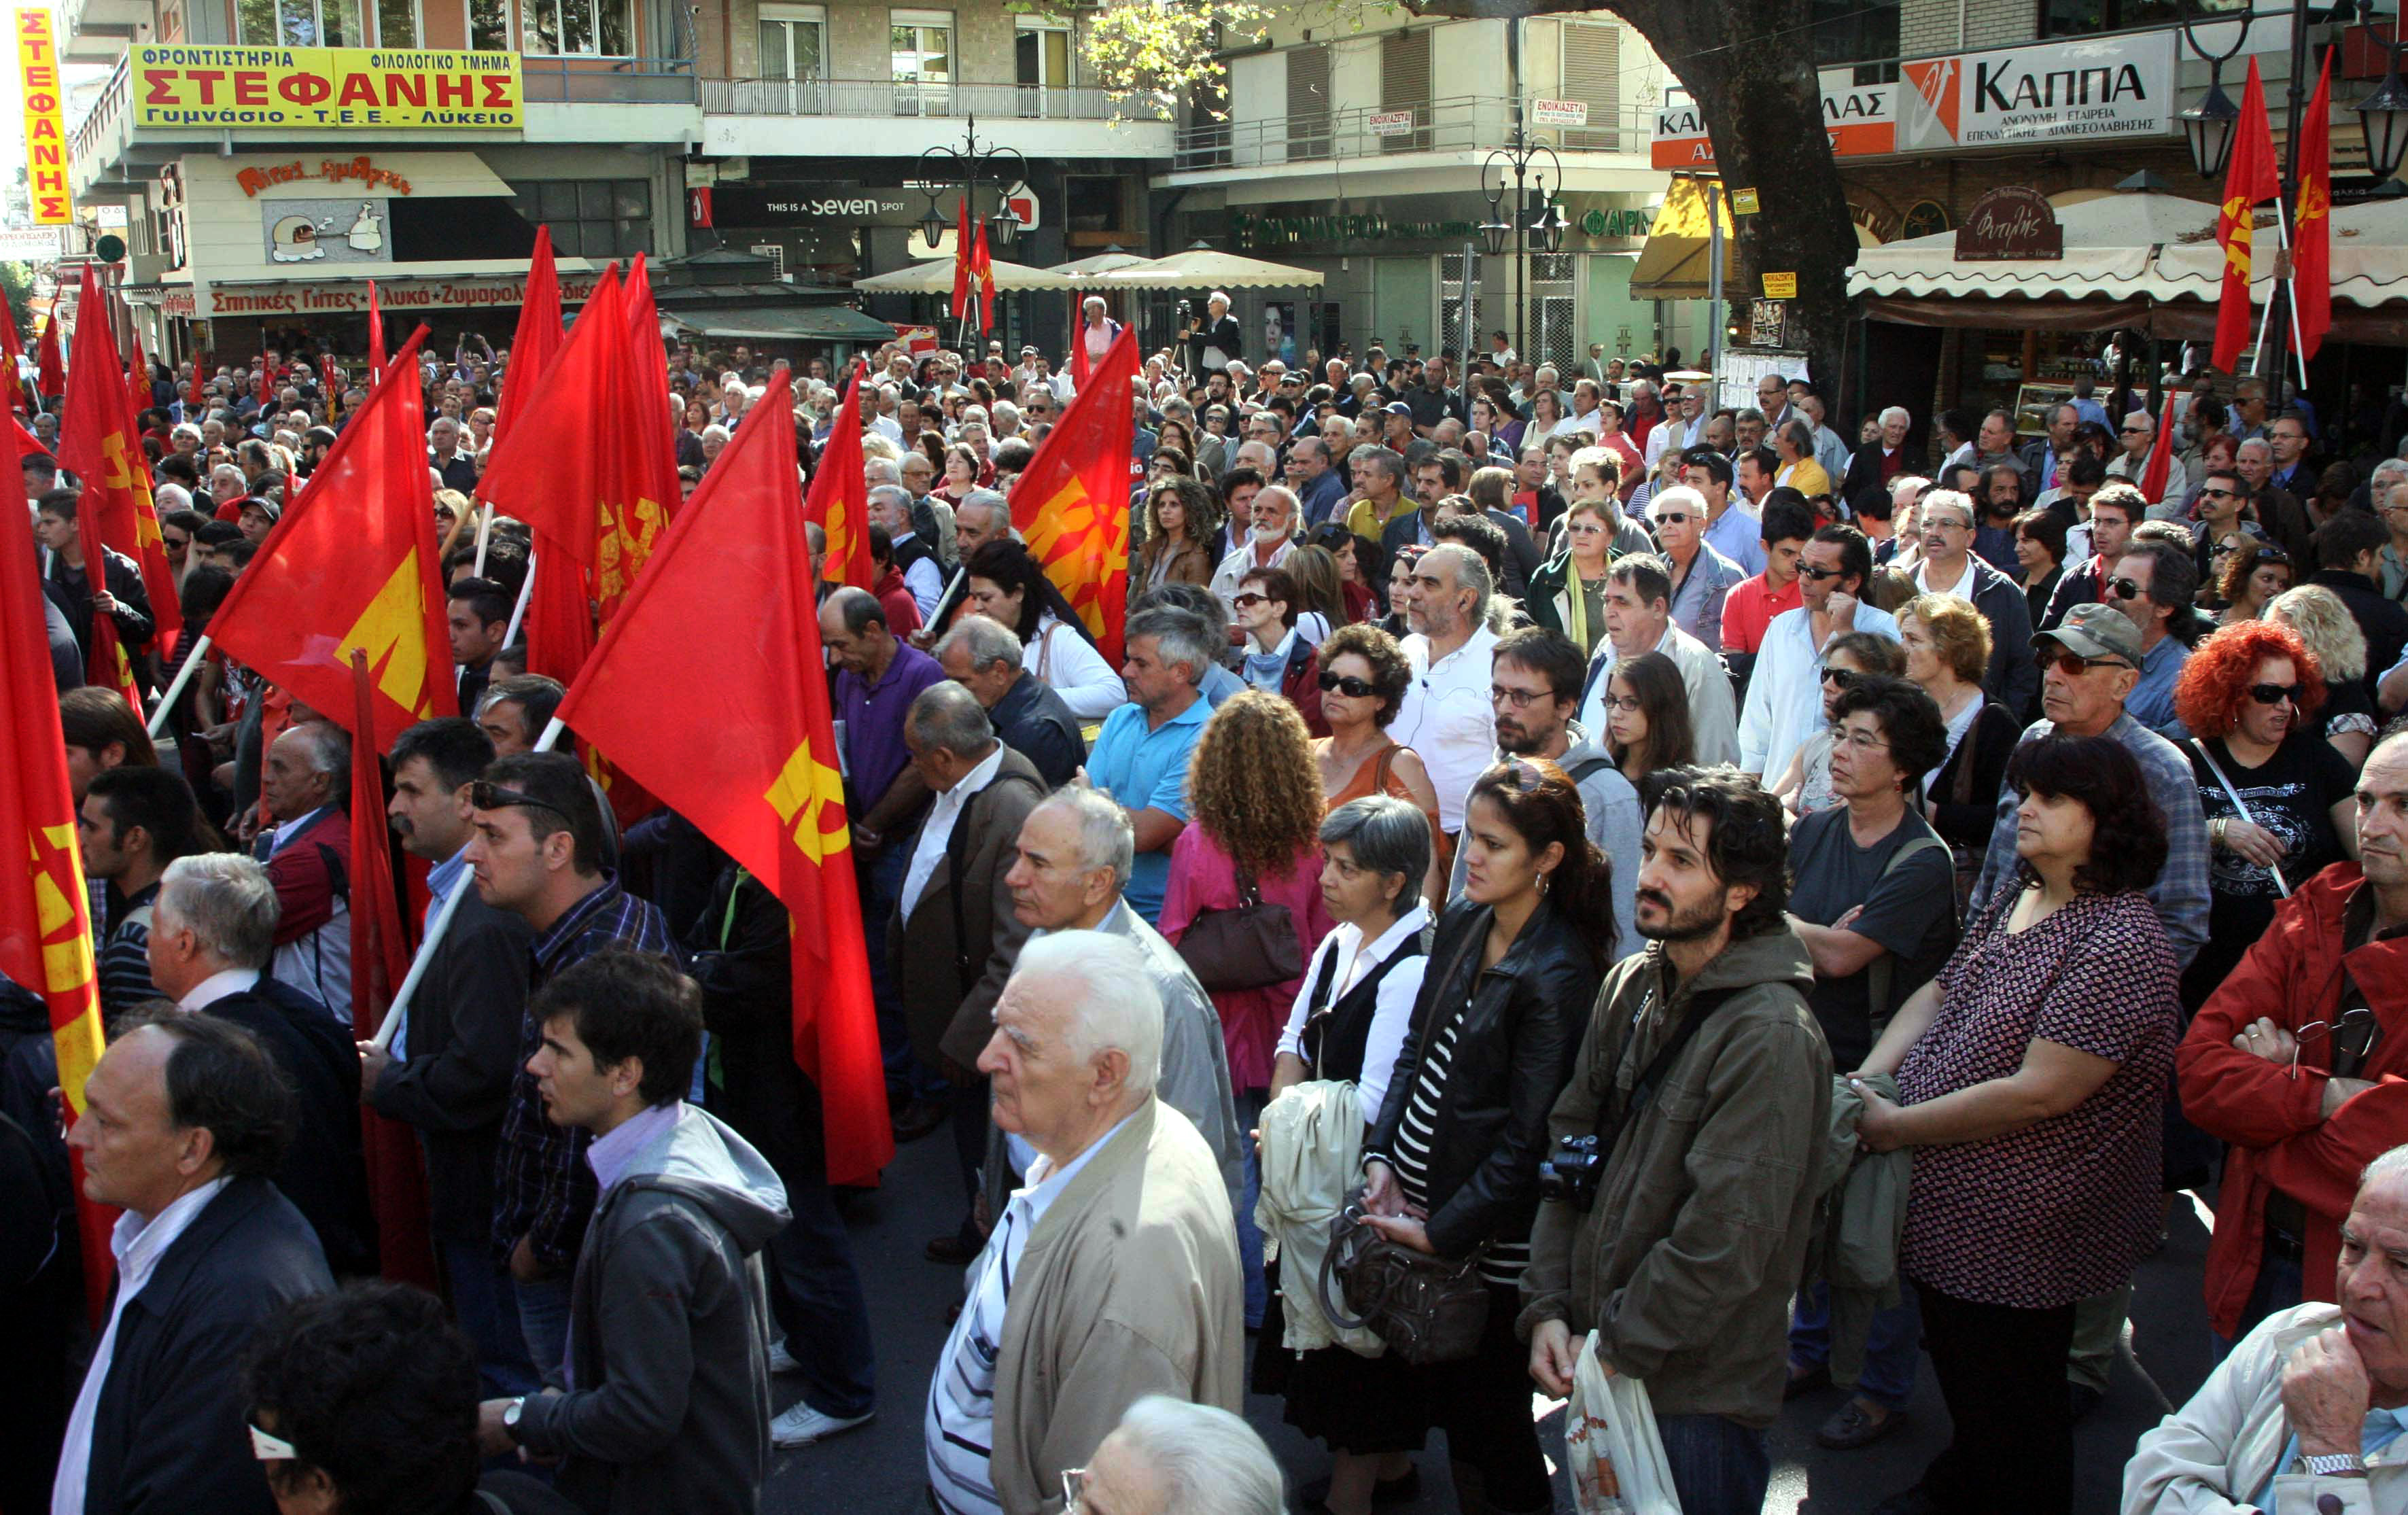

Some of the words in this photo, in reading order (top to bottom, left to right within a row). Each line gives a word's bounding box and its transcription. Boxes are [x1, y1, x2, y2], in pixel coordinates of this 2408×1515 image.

[142, 49, 294, 67] ΦΡΟΝΤΙΣΤΗΡΙΑ
[371, 54, 453, 69] ΦΙΛΟΛΟΓΙΚΟ
[461, 55, 510, 71] ΤΜΗΜΑ
[143, 69, 513, 107] ΣΤΕΦΑΝΗΣ
[21, 13, 65, 217] ΣΤΕΦΑΝΗΣ
[147, 107, 284, 124] Γυμνάσιο
[313, 110, 391, 124] Τ.Ε.Ε.
[421, 110, 514, 124] Λύκειο
[2067, 108, 2116, 121] ΕΤΑΙΡΕΙΑ
[767, 203, 788, 212] THIS
[790, 203, 799, 212] IS
[801, 203, 808, 212] A
[881, 202, 905, 211] SPOT
